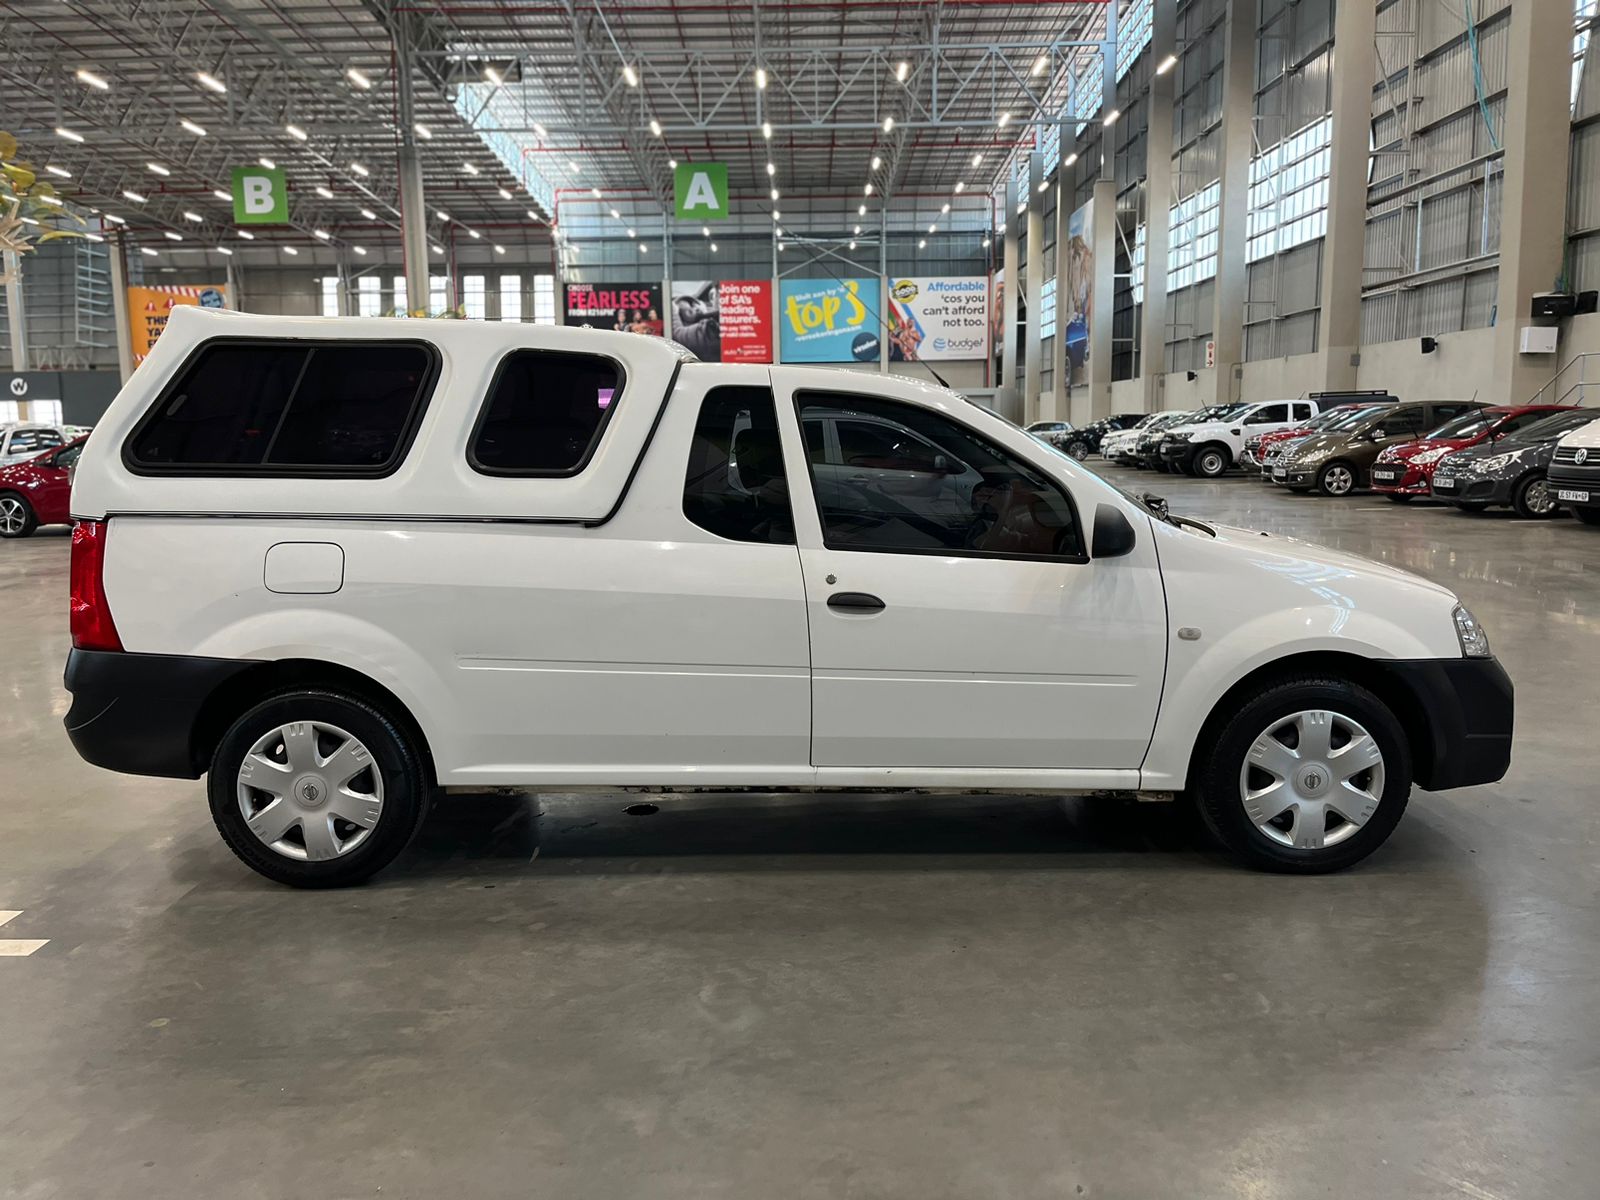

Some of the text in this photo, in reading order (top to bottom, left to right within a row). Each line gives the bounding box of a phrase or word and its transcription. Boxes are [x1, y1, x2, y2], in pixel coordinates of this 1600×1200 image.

[243, 176, 274, 214] B
[683, 172, 720, 209] A
[719, 284, 760, 294] Join one
[927, 281, 985, 291] Affordable
[568, 291, 650, 309] FEARLESS
[719, 295, 752, 304] of SA's
[965, 295, 985, 304] you
[719, 305, 755, 315] leading
[784, 281, 866, 335] top 3
[922, 306, 985, 315] can't afford
[719, 315, 761, 325] insurers.
[943, 318, 985, 327] not too.
[947, 338, 984, 351] budget
